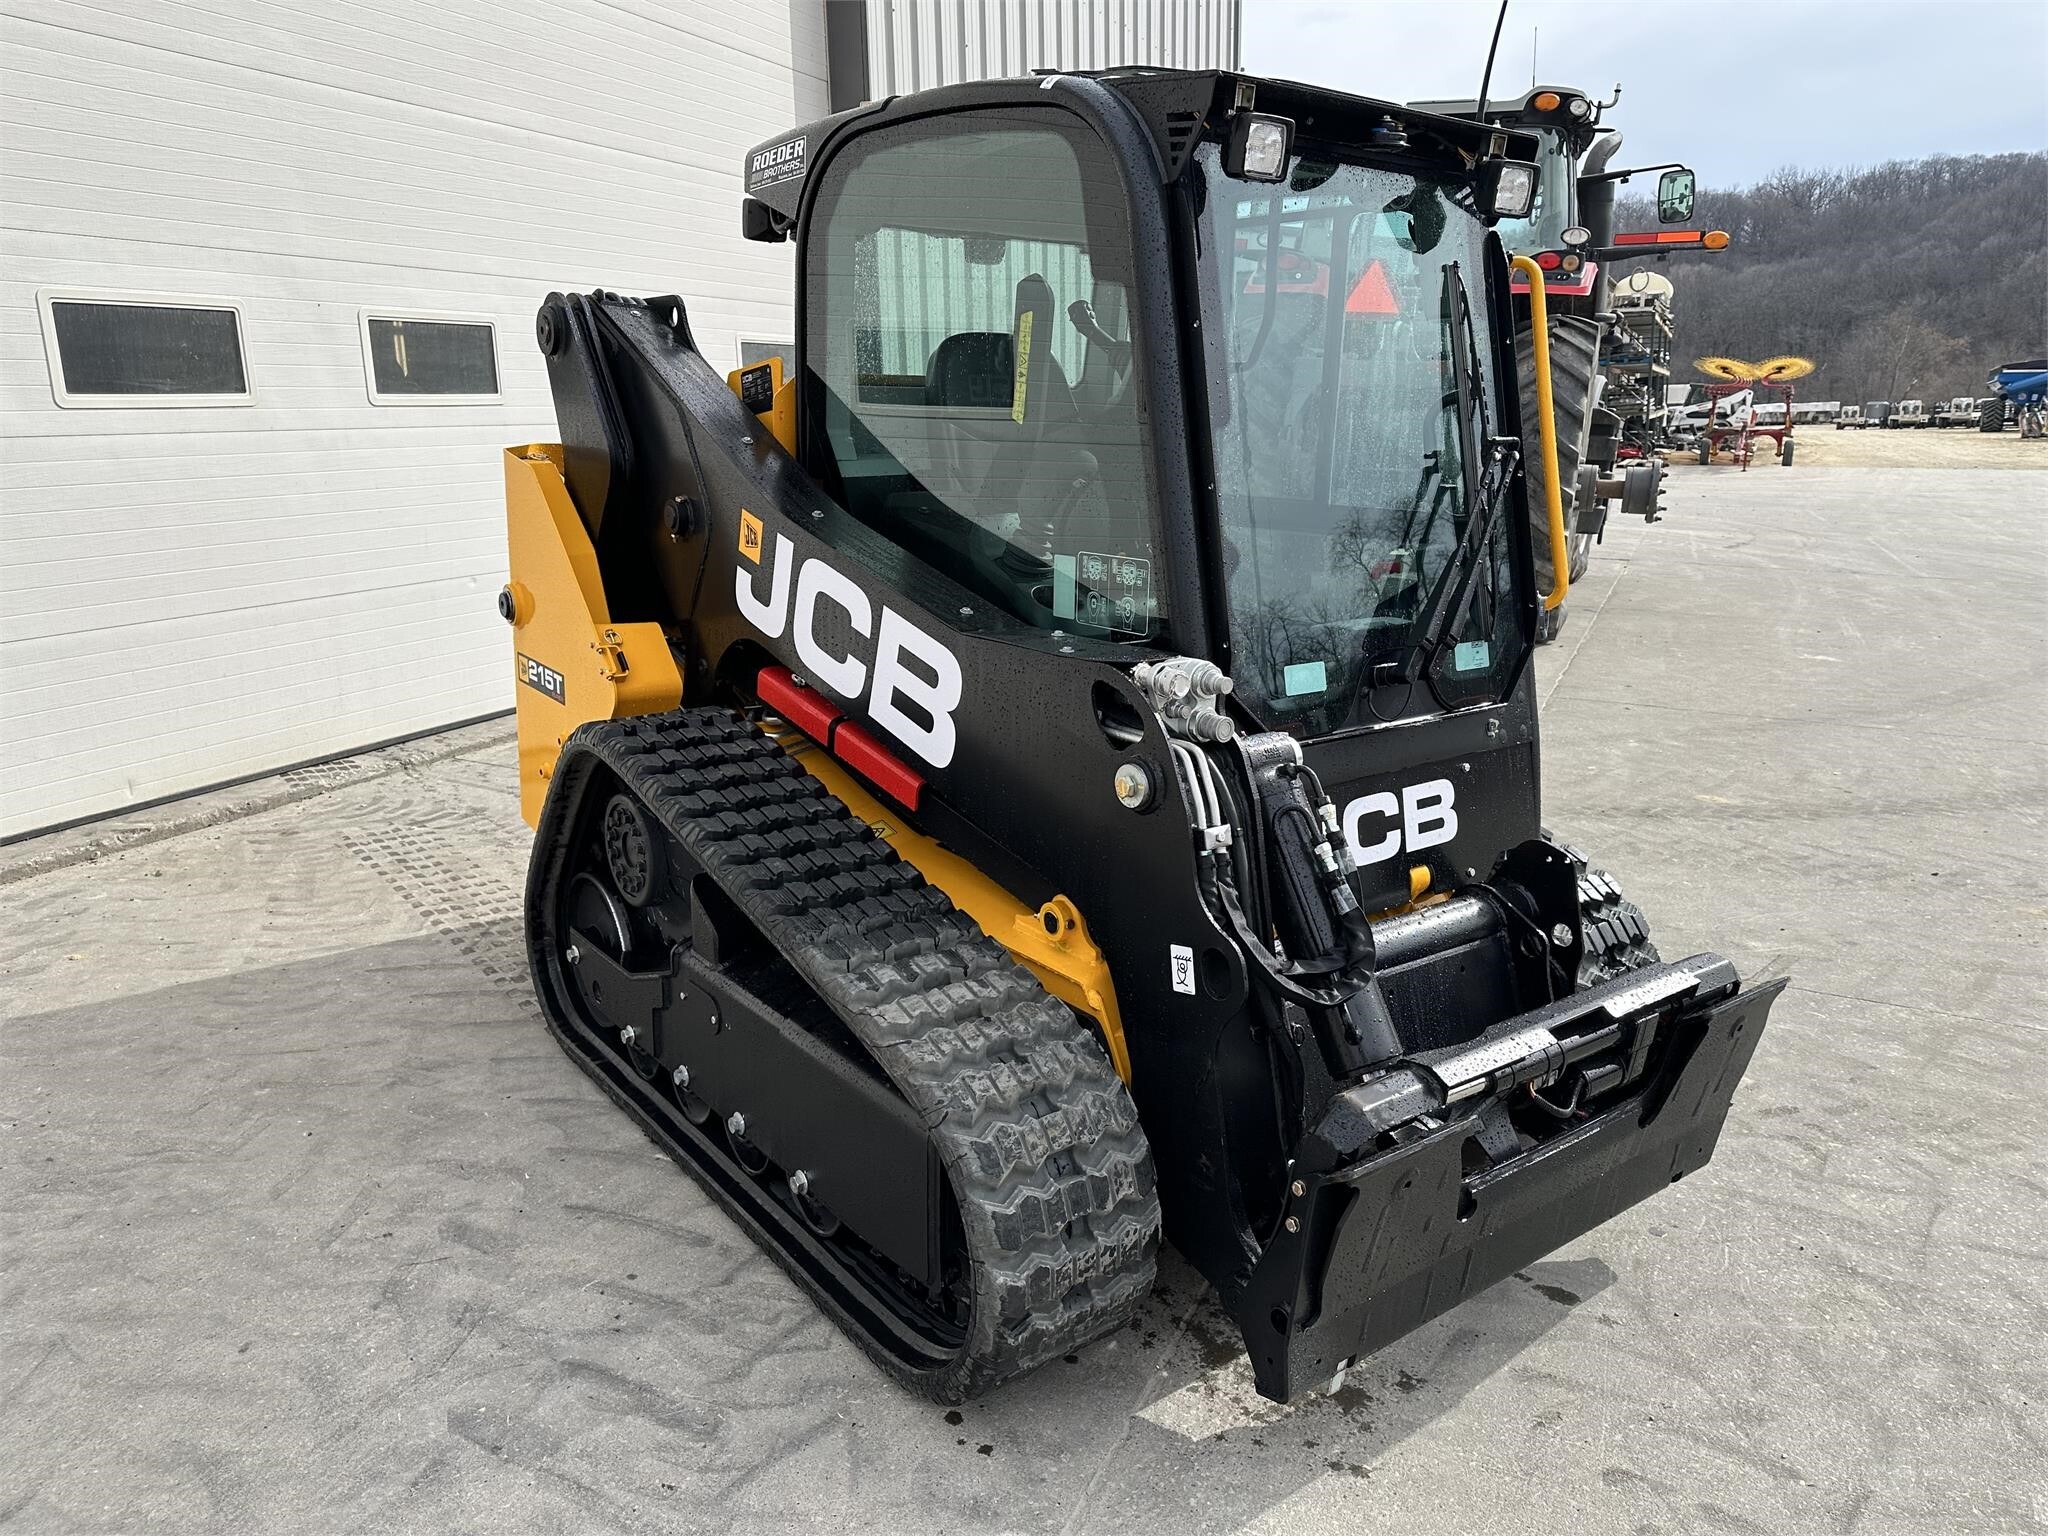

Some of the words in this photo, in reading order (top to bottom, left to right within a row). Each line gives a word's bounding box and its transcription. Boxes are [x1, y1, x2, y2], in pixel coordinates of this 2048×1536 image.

[752, 139, 804, 172] ROEDER
[763, 159, 801, 179] BROTHERS
[744, 522, 758, 546] JCB
[735, 532, 963, 769] JCB
[528, 659, 563, 695] 215T
[1342, 778, 1459, 867] CB
